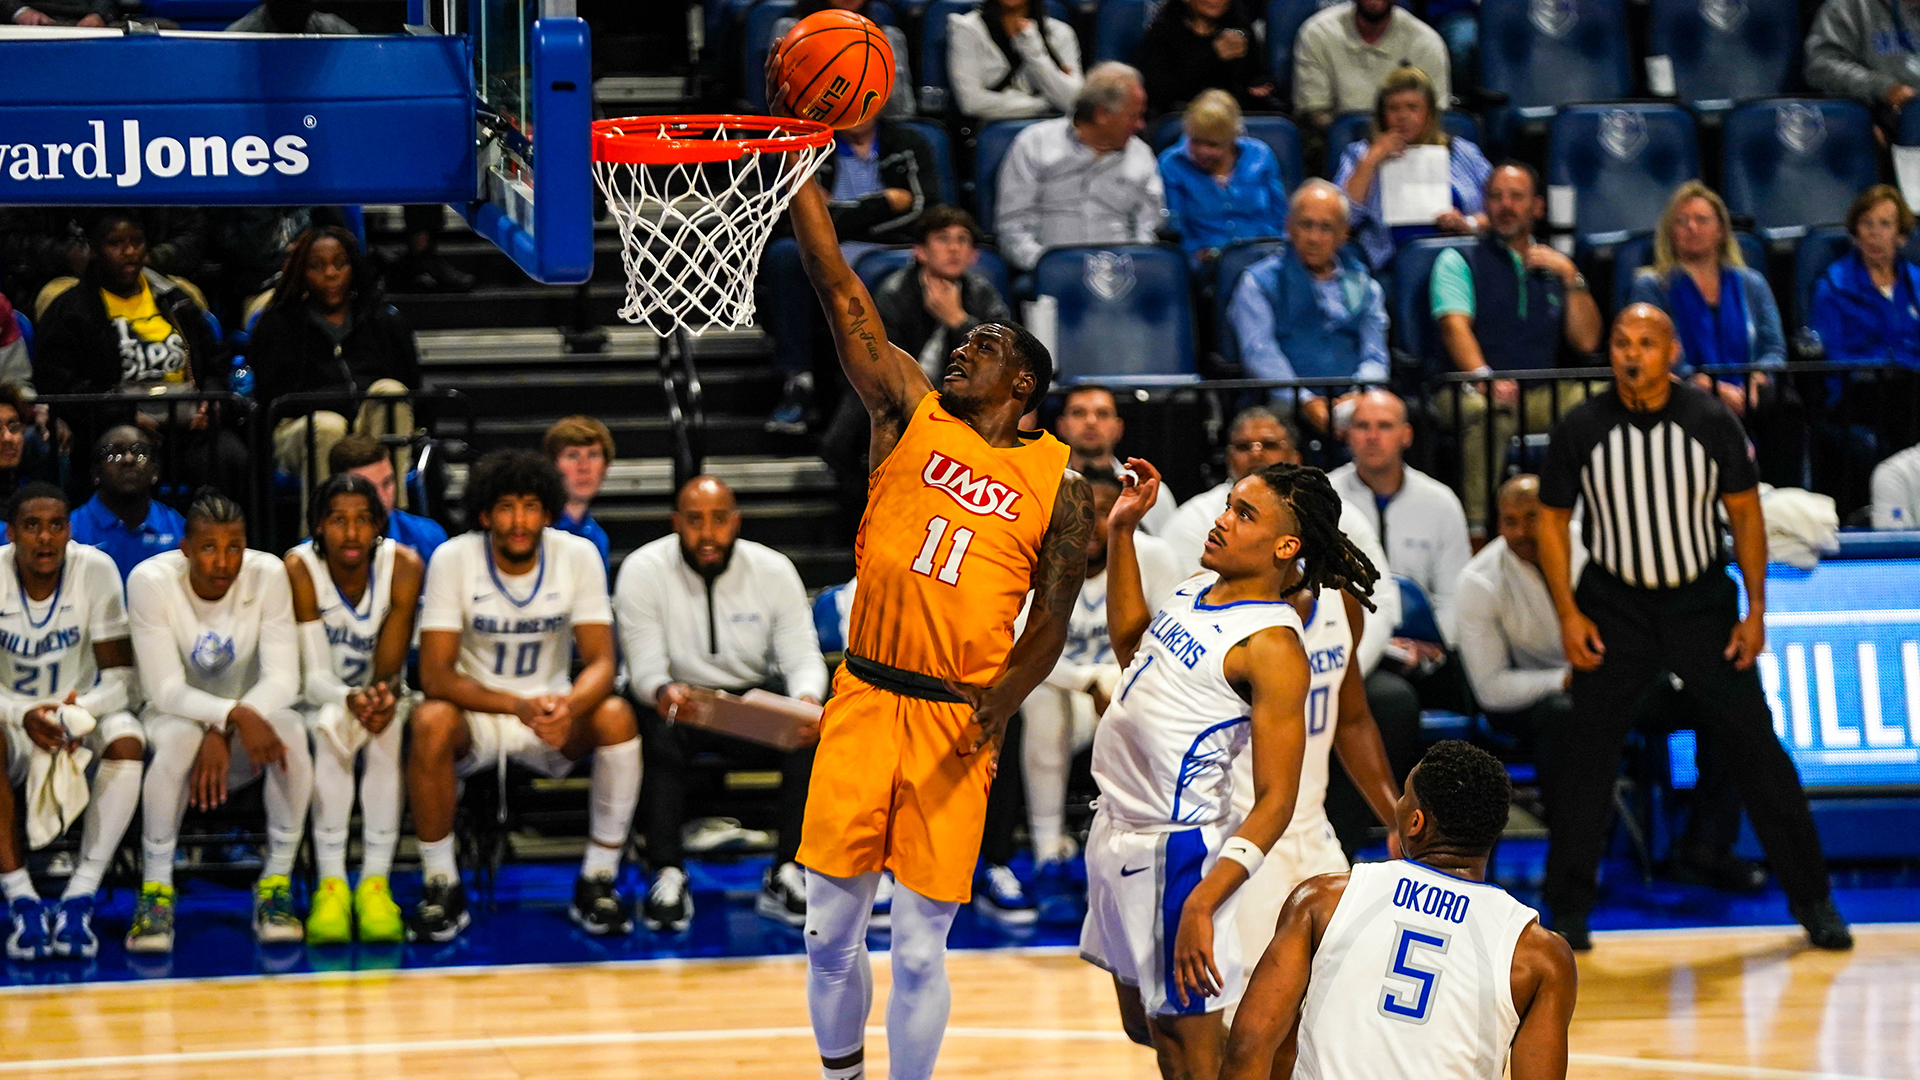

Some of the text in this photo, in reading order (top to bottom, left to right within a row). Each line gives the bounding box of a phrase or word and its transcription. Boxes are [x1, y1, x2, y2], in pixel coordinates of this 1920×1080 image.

[806, 75, 851, 121] ELITE
[921, 450, 1023, 522] UMSL
[910, 515, 976, 588] 11
[12, 661, 60, 697] 21
[494, 641, 542, 678] 10
[1119, 654, 1154, 702] 1
[1392, 877, 1471, 924] OKORO
[1377, 921, 1452, 1025] 5
